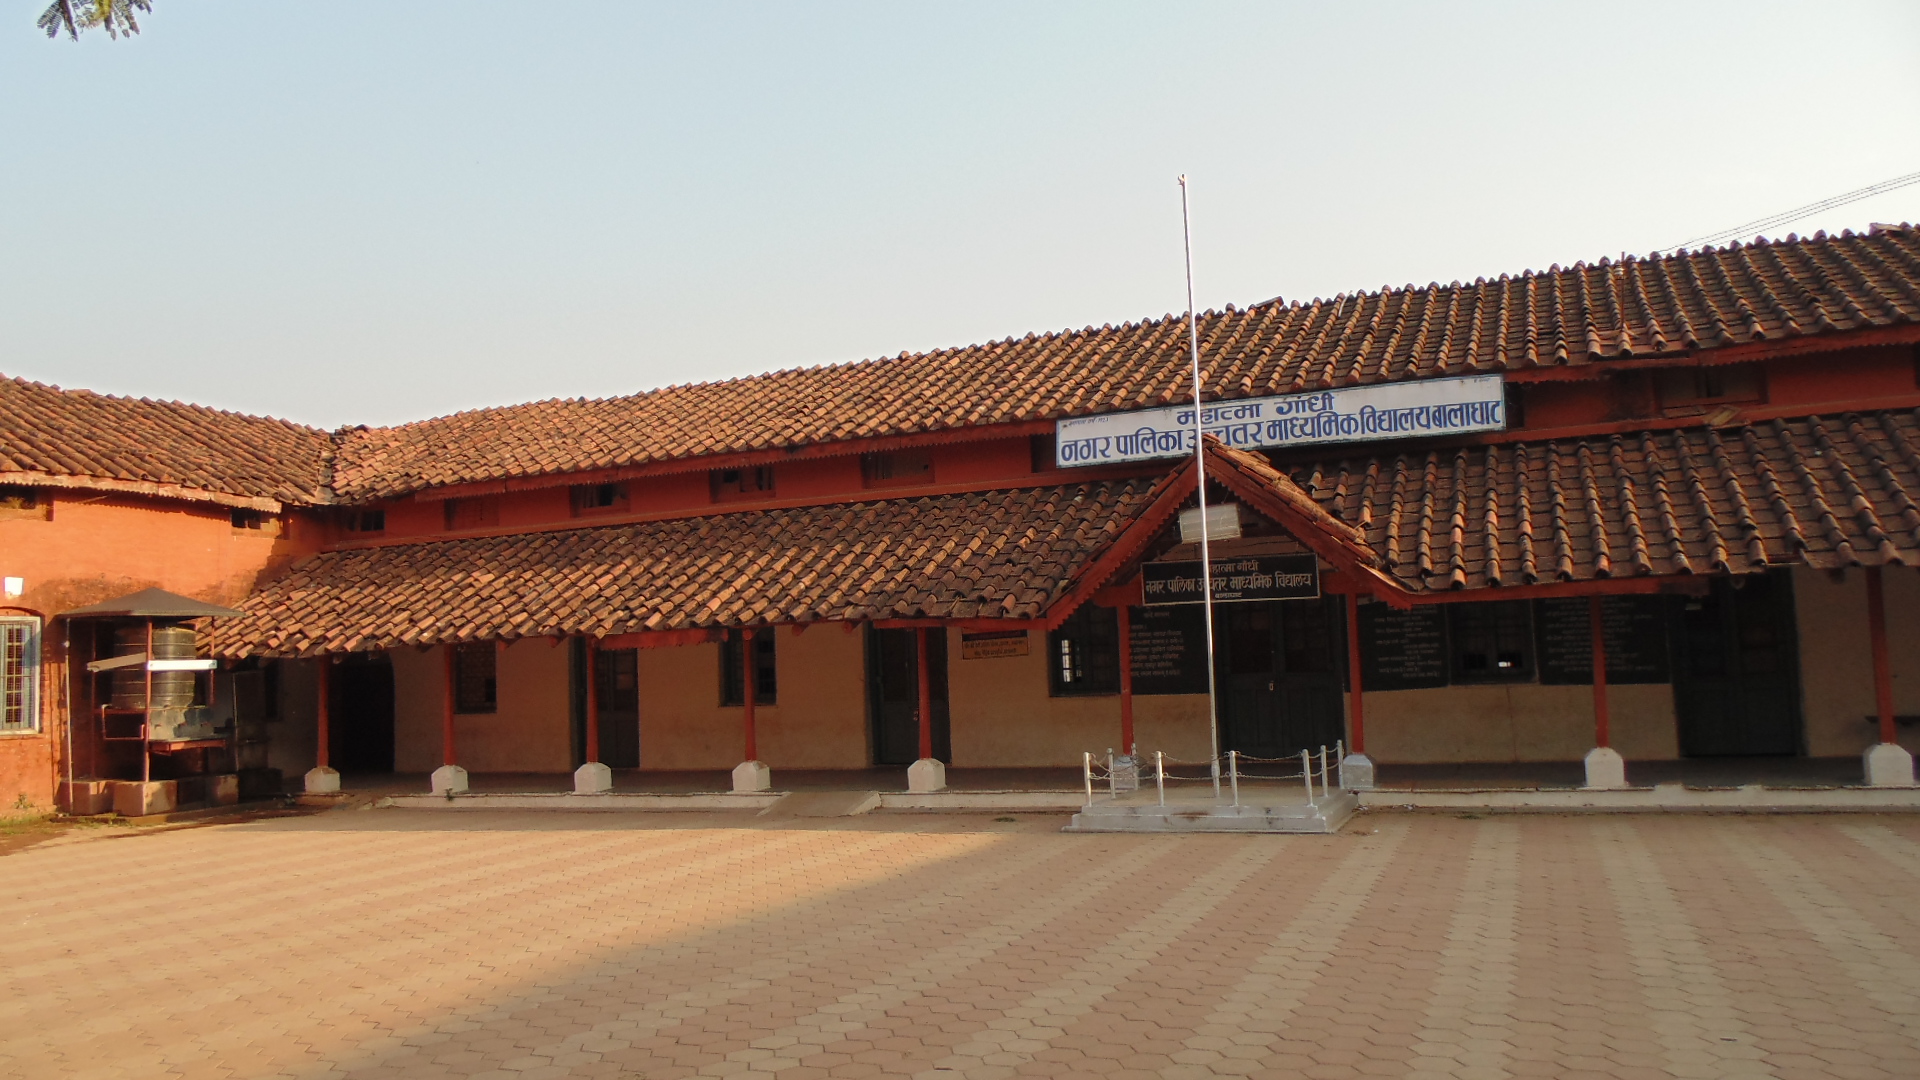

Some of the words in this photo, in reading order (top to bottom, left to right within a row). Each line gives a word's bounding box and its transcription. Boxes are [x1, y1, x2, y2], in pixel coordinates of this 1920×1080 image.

[1177, 403, 1263, 426] महात्मा
[1274, 392, 1334, 415] गांधी
[1061, 435, 1112, 462] नगर
[1113, 426, 1184, 456] पालिका
[1266, 411, 1357, 442] माध्यमिक
[1359, 405, 1432, 434] विद्यालय
[1431, 400, 1502, 428] बालाघाट
[1145, 580, 1166, 594] नगर
[1167, 576, 1196, 593] पालिका
[1230, 572, 1272, 590] माध्यमिक
[1275, 571, 1313, 589] विद्यालय
[1206, 562, 1236, 575] हात्मा
